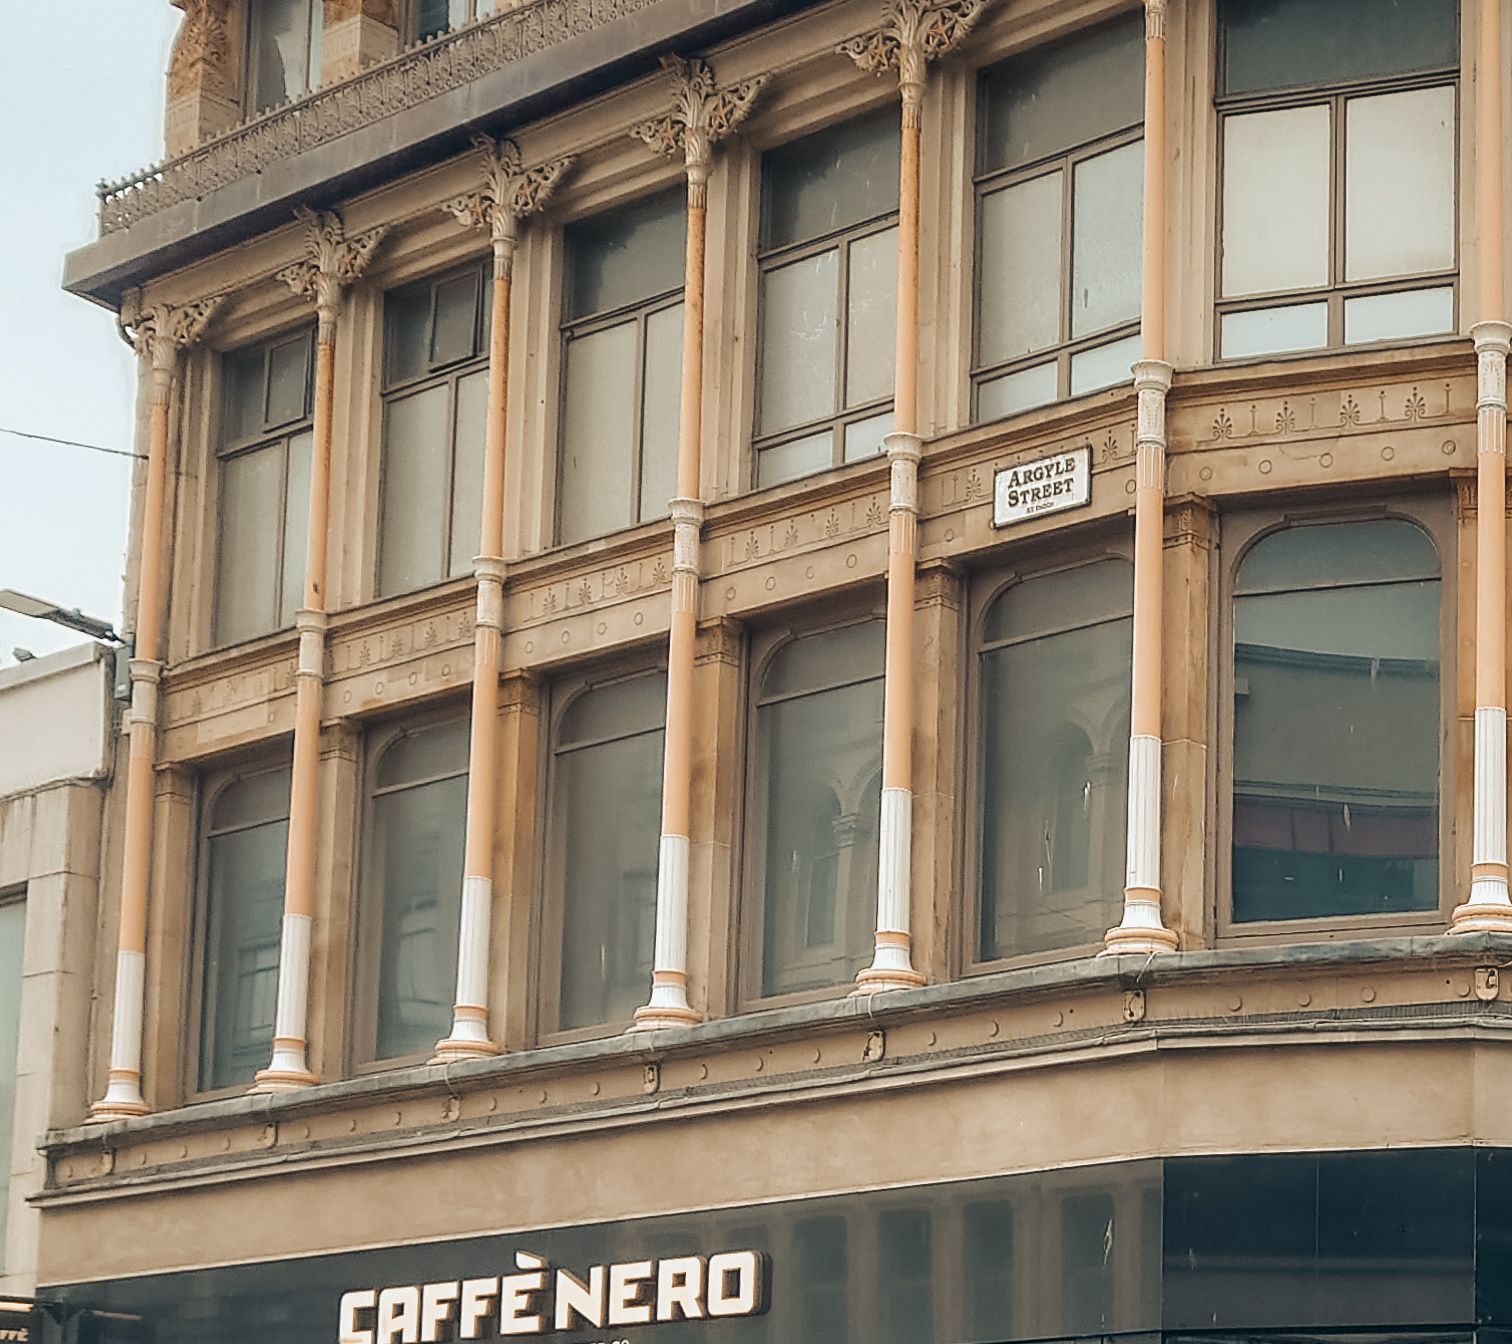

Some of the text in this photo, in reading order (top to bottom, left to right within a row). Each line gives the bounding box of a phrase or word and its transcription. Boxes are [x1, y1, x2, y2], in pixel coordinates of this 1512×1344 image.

[1008, 457, 1076, 488] ARGYLE
[1008, 478, 1074, 508] STREET
[554, 1249, 760, 1331] NERO
